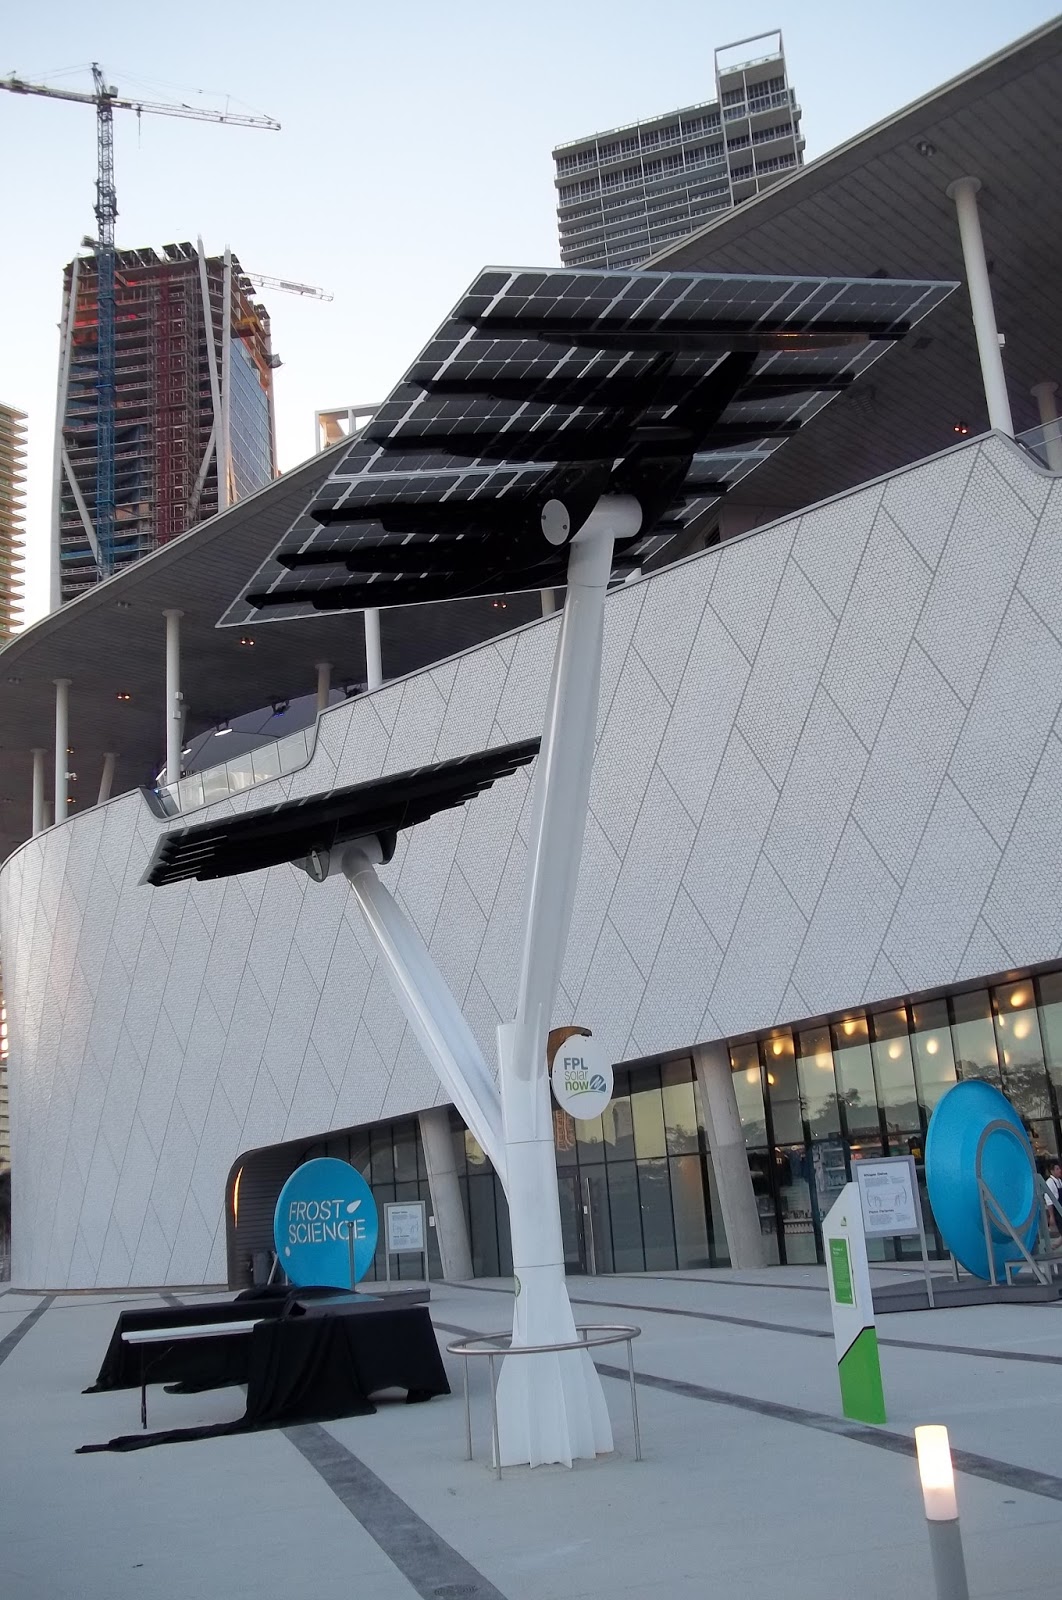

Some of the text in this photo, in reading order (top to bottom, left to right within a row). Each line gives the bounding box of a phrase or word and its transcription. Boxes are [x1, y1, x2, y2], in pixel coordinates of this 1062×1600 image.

[563, 1057, 588, 1070] FPL
[564, 1071, 588, 1081] solar
[565, 1081, 588, 1091] now
[289, 1199, 345, 1221] FROST
[288, 1219, 366, 1244] SCIENCE
